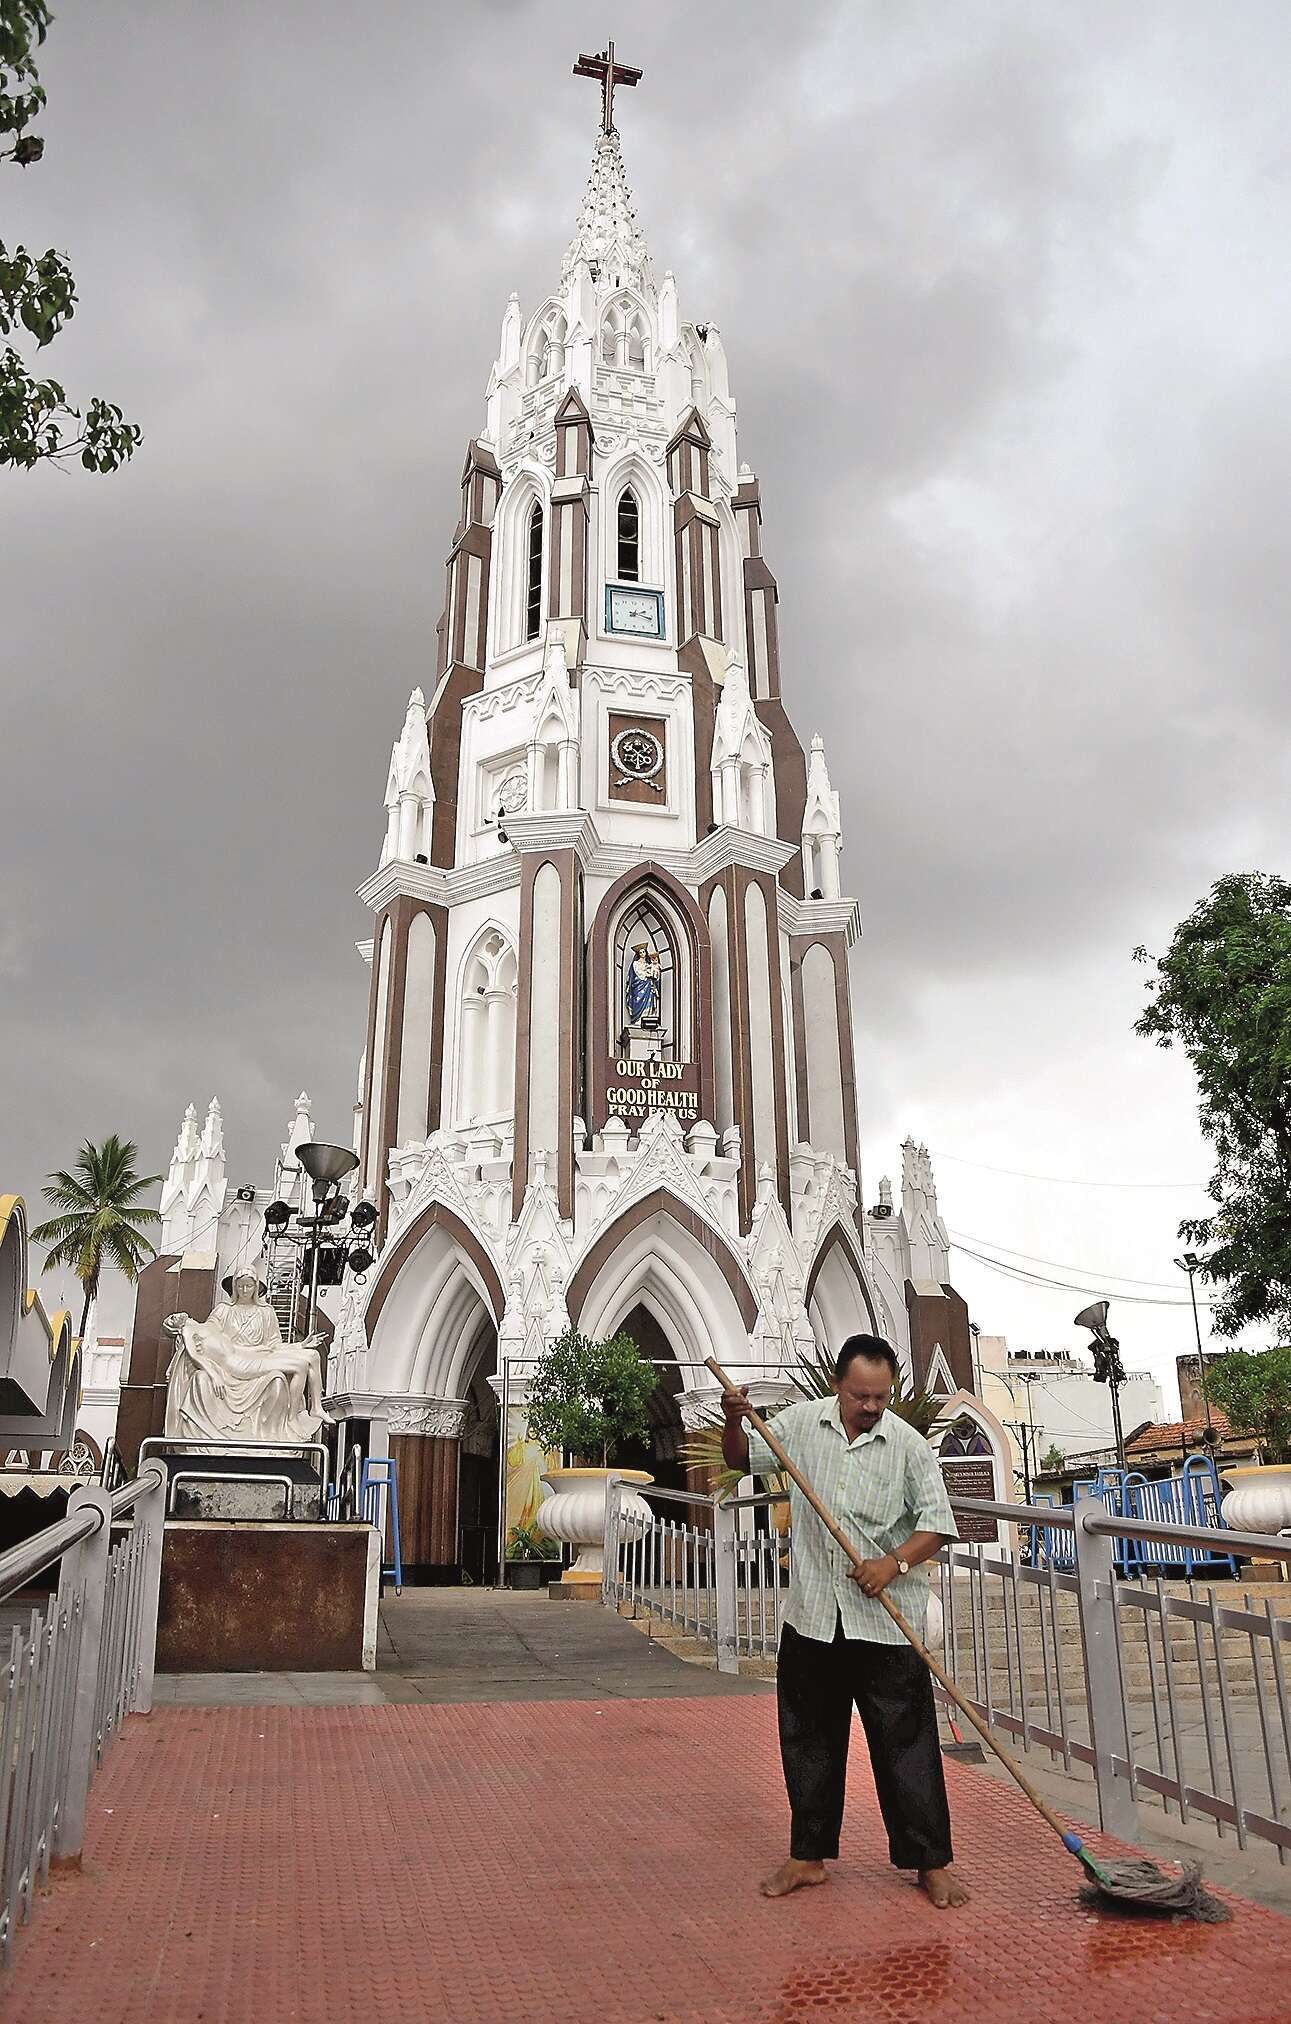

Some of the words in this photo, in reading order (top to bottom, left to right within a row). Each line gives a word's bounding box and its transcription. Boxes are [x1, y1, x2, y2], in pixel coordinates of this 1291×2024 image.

[616, 1060, 646, 1076] OUR
[649, 1062, 684, 1079] LADY
[641, 1078, 660, 1089] OF
[606, 1087, 647, 1104] GOOD
[648, 1090, 698, 1107] HEALTH
[608, 1104, 646, 1117] PRAY
[679, 1109, 698, 1119] US
